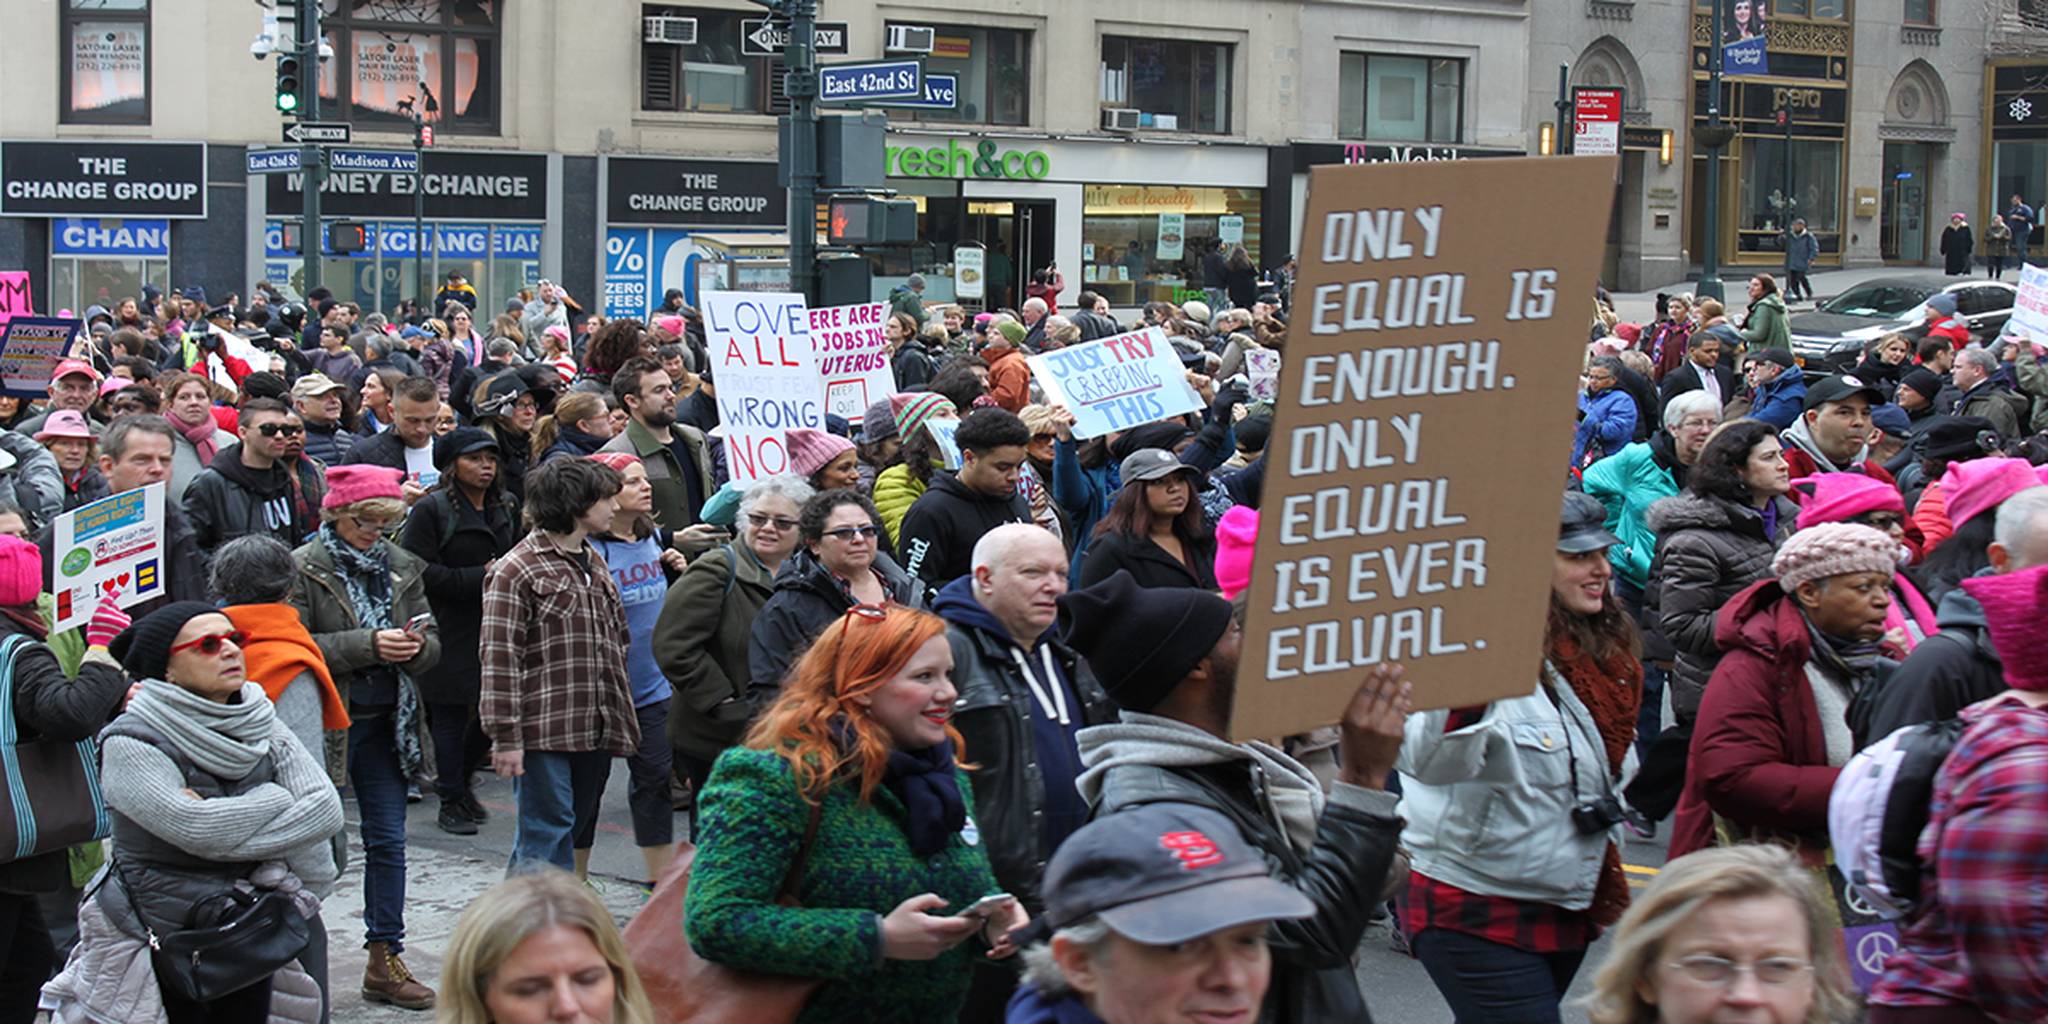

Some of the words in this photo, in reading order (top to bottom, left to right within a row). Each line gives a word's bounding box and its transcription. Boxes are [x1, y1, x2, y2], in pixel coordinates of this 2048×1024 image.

[760, 31, 788, 44] ONE
[816, 32, 834, 43] AY
[825, 76, 856, 94] East
[860, 73, 895, 92] 42nd
[898, 70, 915, 89] St
[925, 83, 953, 101] Ave
[1772, 88, 1821, 111] pera
[293, 128, 311, 137] ONE
[321, 128, 341, 137] WAY
[78, 157, 127, 175] THE
[250, 155, 268, 168] East
[333, 152, 388, 168] Madison
[391, 155, 417, 169] Ave
[886, 138, 1050, 180] resh&co
[6, 181, 107, 199] CHANGE
[114, 183, 197, 200] GROUP
[391, 174, 528, 196] EXCHANGE
[683, 173, 718, 189] THE
[629, 194, 703, 211] CHANGE
[708, 197, 768, 212] GROUP
[1322, 206, 1443, 263] ONLY
[605, 282, 645, 294] ZERO
[605, 295, 645, 307] FEES
[1311, 273, 1475, 335] EQUAL
[1505, 269, 1557, 321] IS
[708, 301, 809, 335] LOVE
[809, 309, 841, 330] ERE
[849, 305, 883, 326] ARE
[822, 331, 863, 351] JOBS
[867, 327, 887, 347] IN
[725, 336, 799, 367] ALL
[821, 351, 885, 375] UTERUS
[1048, 343, 1104, 378] JUST
[1104, 332, 1155, 363] TRY
[717, 373, 777, 394] TRUST
[781, 376, 815, 394] FEW
[1065, 362, 1163, 402] GRABBING
[1300, 340, 1516, 407] ENOUGH.
[721, 397, 819, 429] WRONG
[1093, 393, 1165, 429] THIS
[1289, 412, 1422, 477] ONLY
[1280, 477, 1467, 545] EQUAL
[1272, 556, 1331, 614] IS
[1347, 537, 1487, 602] EVER
[1266, 606, 1487, 680] EQUAL.
